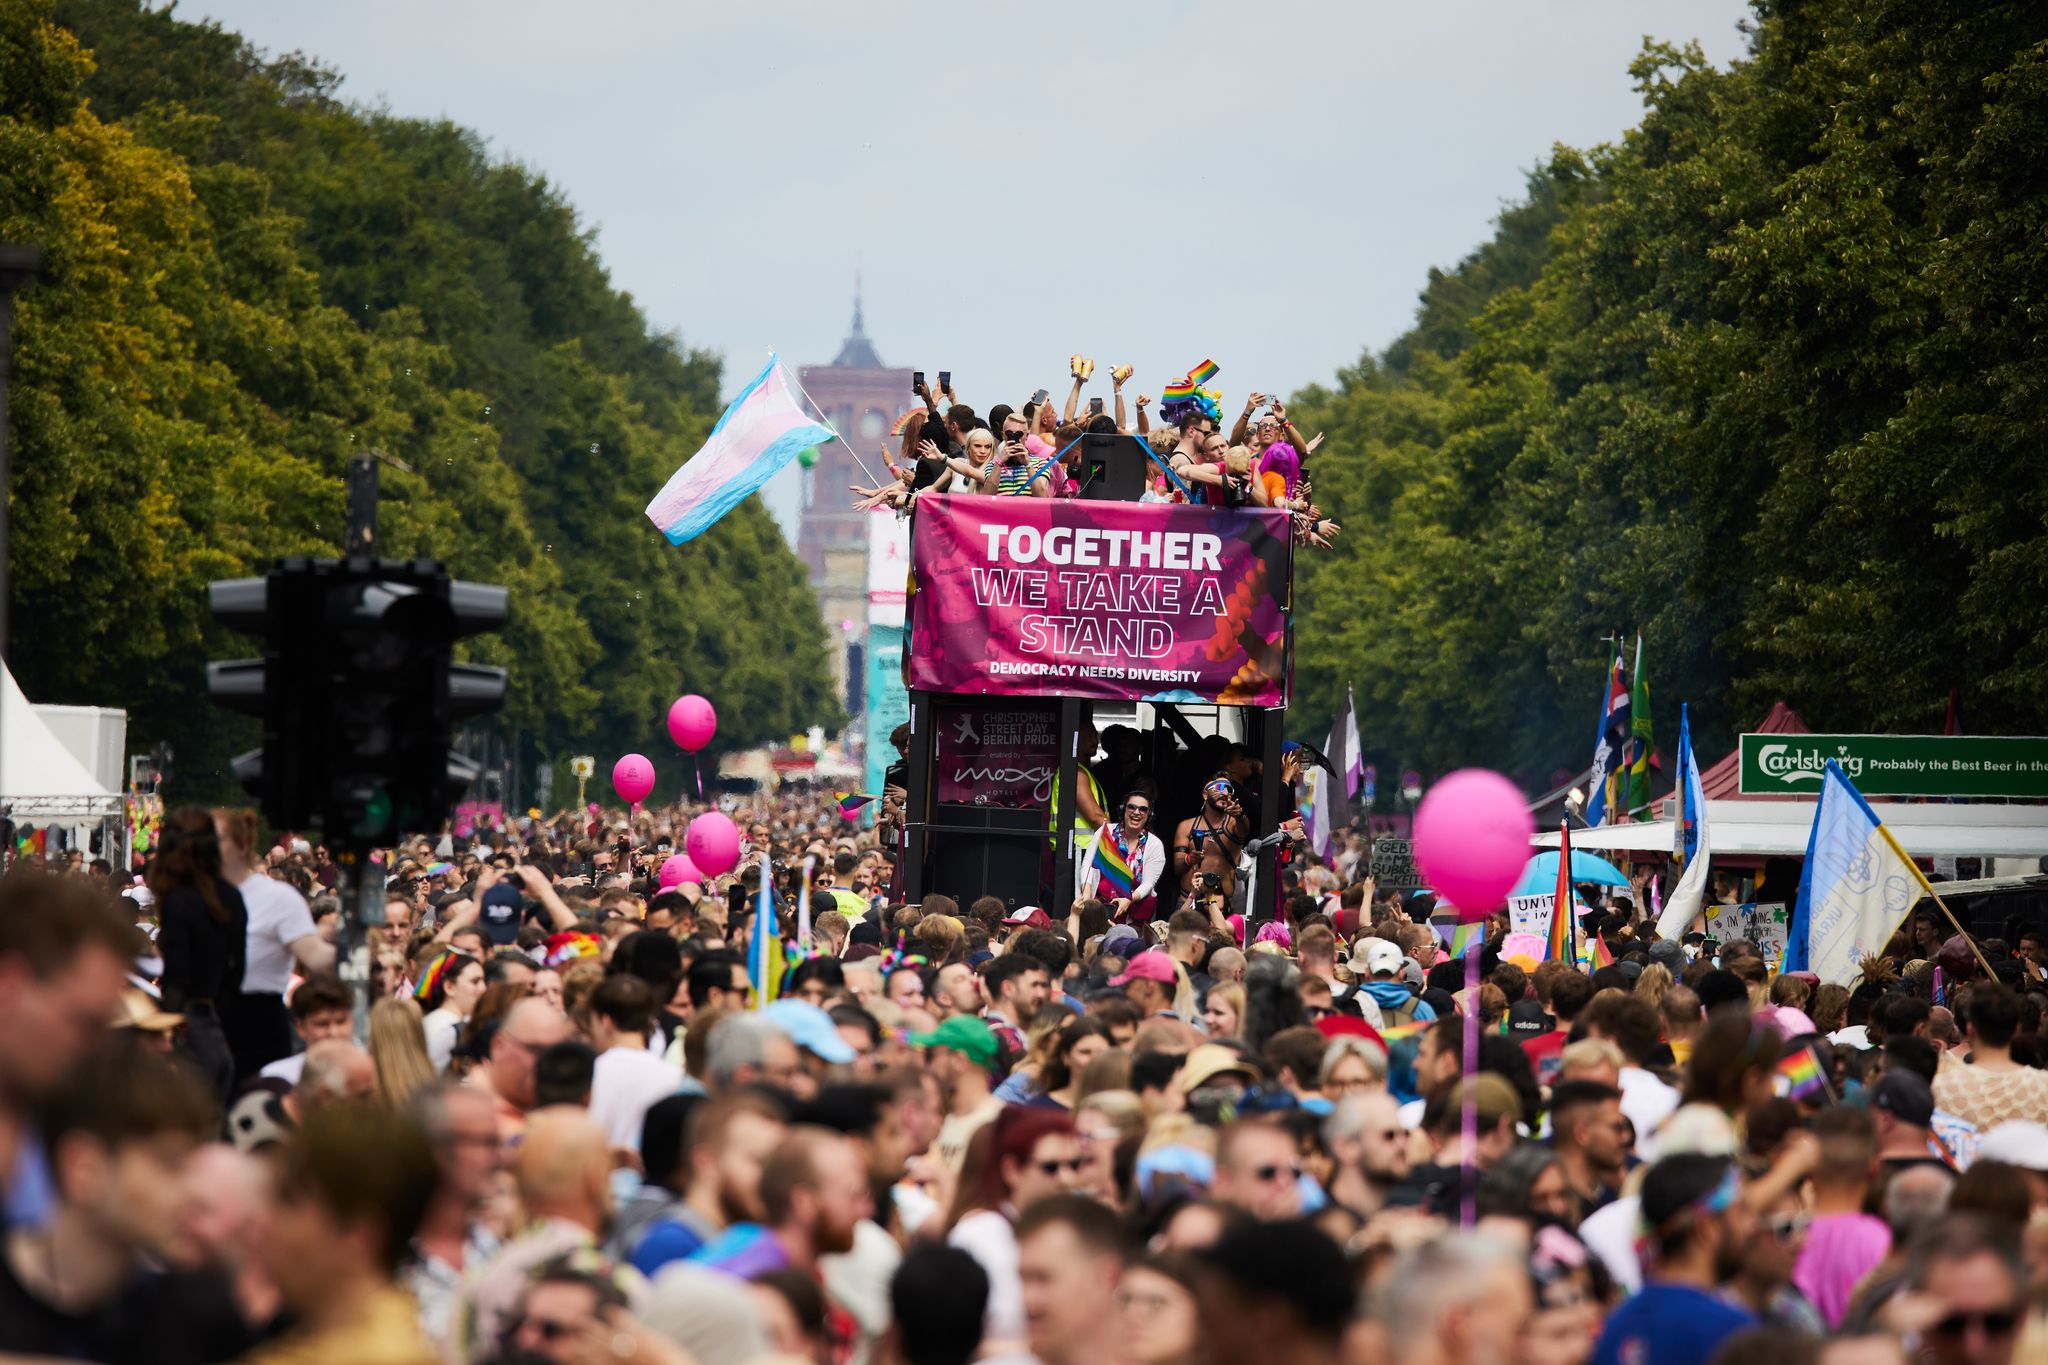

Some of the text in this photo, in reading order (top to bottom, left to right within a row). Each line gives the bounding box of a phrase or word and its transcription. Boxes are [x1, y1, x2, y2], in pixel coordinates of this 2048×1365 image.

[979, 524, 1222, 571] TOGETHER
[970, 567, 1228, 617] WE TAKE A
[1018, 614, 1174, 659] STAND
[989, 661, 1201, 684] DEMOCRACY NEEDS DIVERSITY
[983, 712, 1056, 723] CHRISTOPHER
[983, 724, 1048, 734] STREET DAY
[984, 734, 1056, 744] BERLIN PRIDE
[1758, 744, 1864, 779] Carlsbrg
[1870, 759, 1926, 772] Probably
[1929, 759, 1948, 770] the
[1952, 760, 1980, 771] Best
[1984, 761, 2012, 771] Beer
[2016, 760, 2027, 771] in
[954, 767, 1055, 802] moxy
